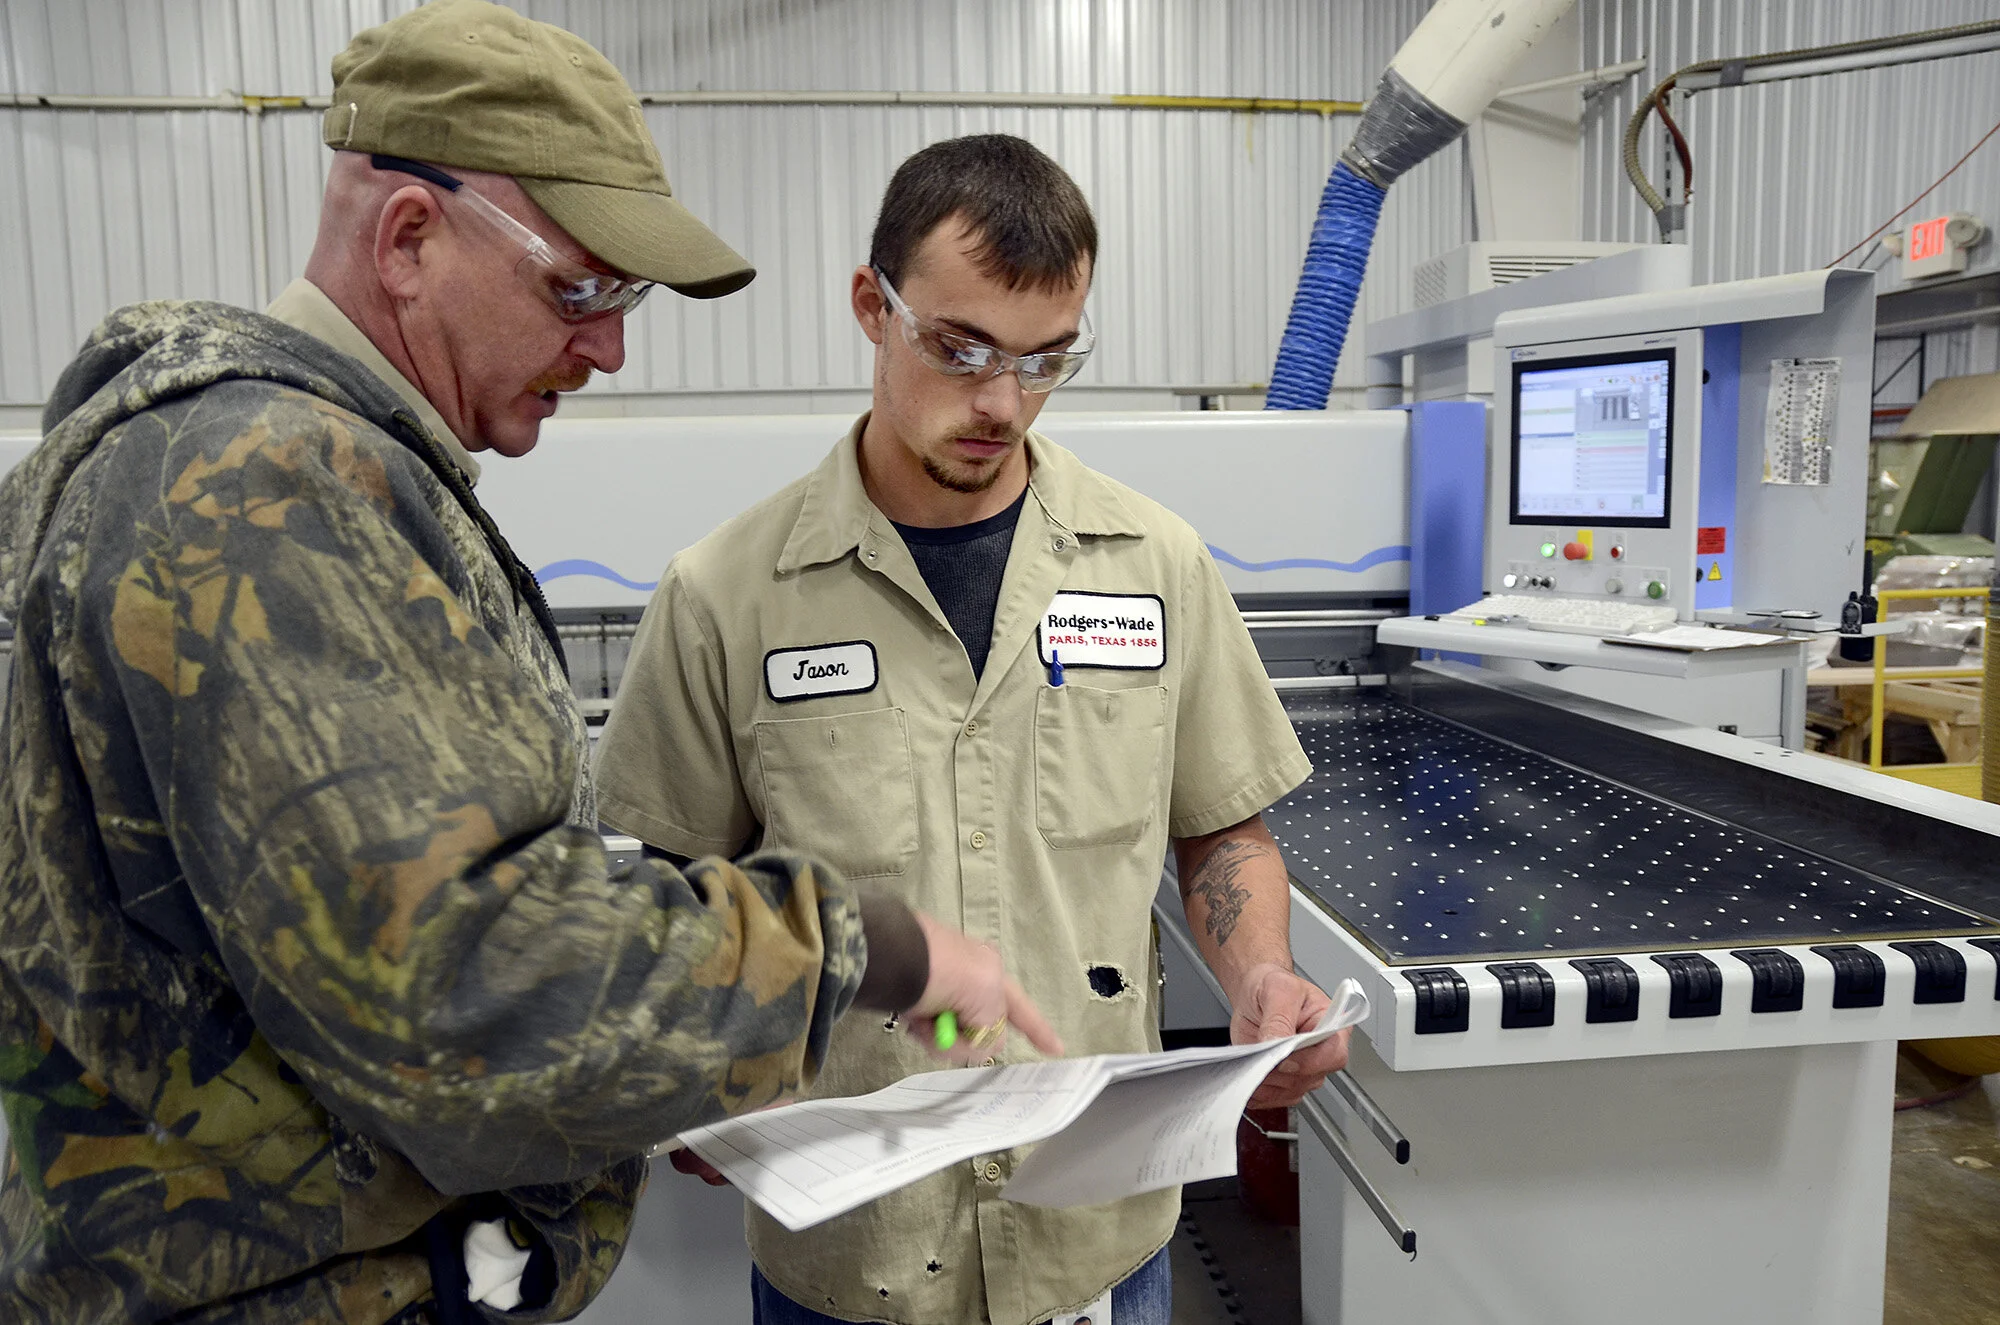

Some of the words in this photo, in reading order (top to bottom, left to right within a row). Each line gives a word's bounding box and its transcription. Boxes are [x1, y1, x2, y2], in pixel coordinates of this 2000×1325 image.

[1911, 216, 1950, 261] EXIT
[1048, 614, 1155, 632] Rodgers-Wade
[1049, 635, 1089, 646] PARIS,
[1091, 636, 1127, 646] TEXAS
[793, 660, 849, 680] Jason
